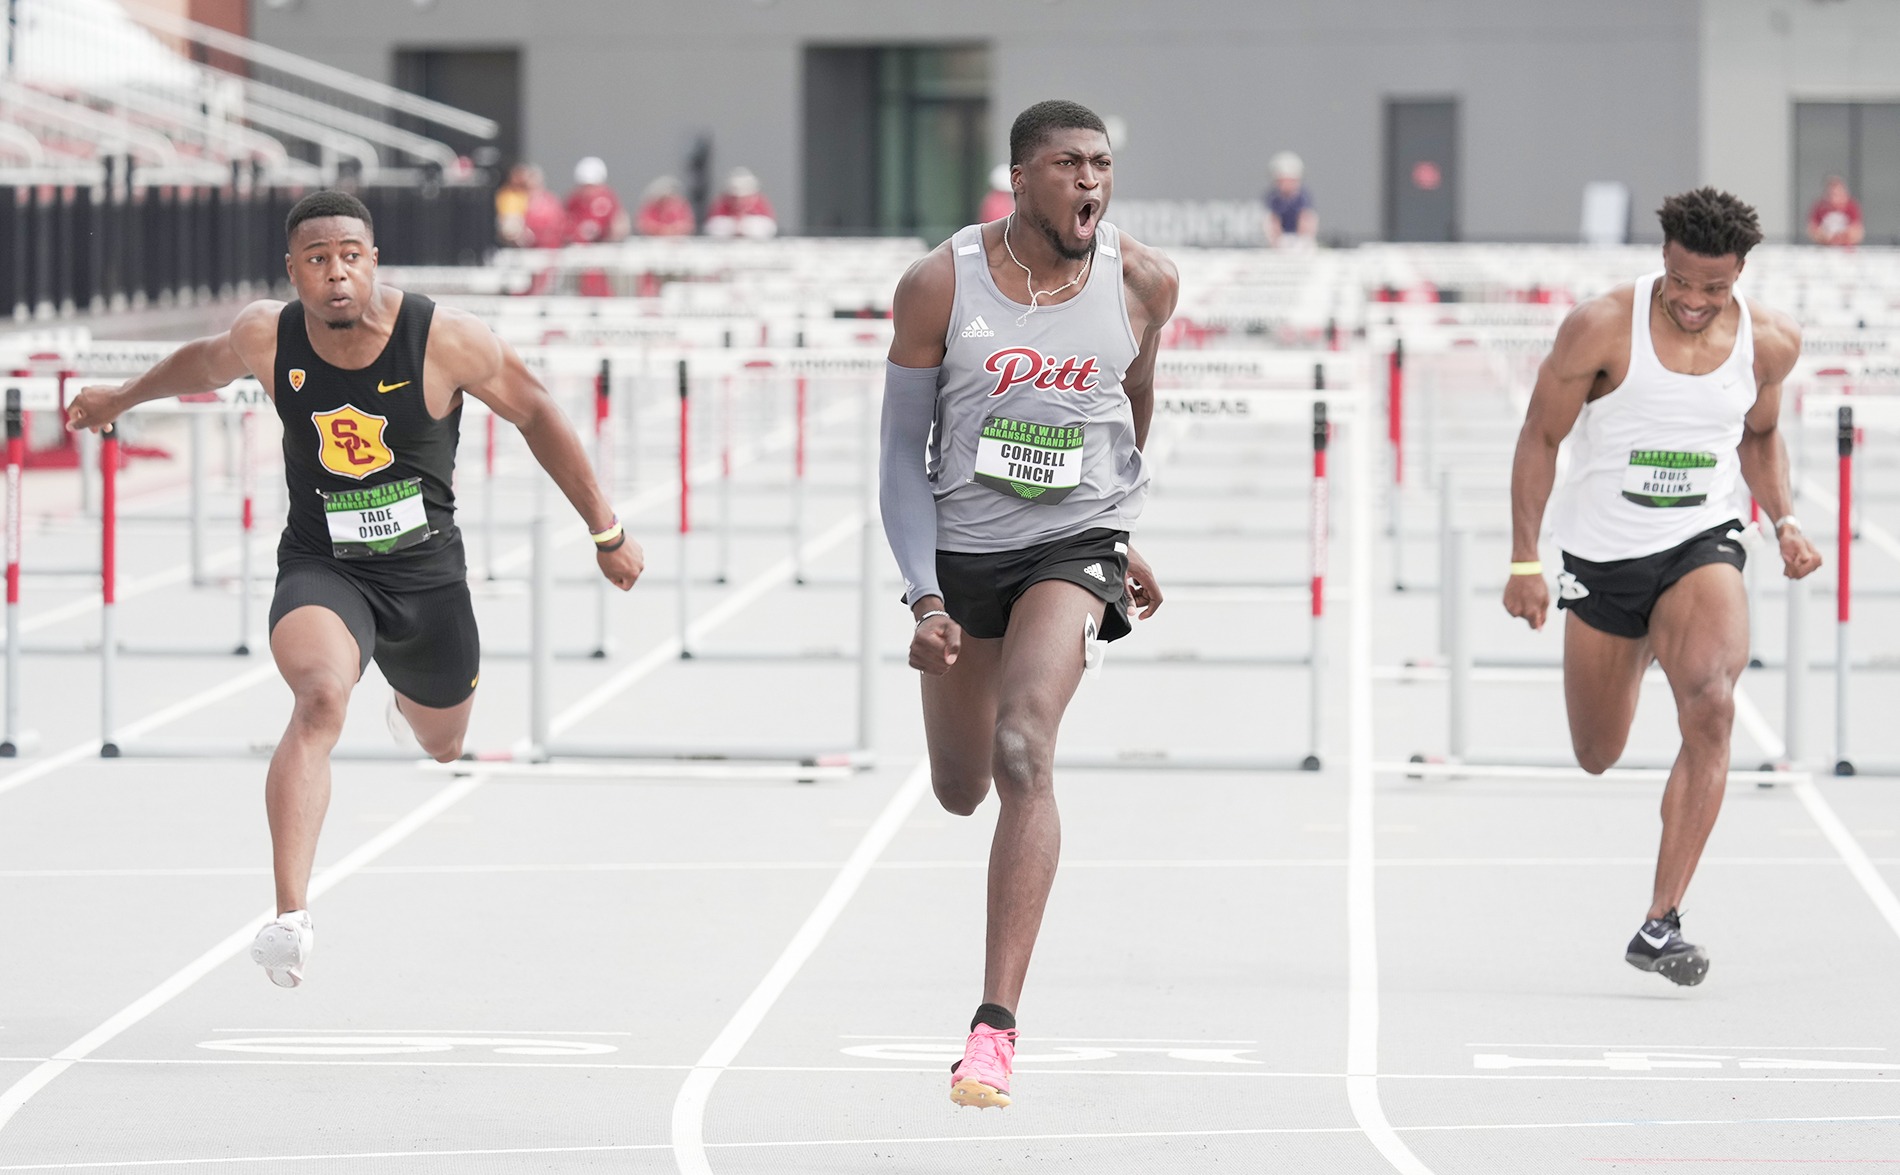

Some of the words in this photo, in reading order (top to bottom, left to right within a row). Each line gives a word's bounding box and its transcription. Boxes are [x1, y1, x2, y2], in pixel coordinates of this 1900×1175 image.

[961, 328, 995, 338] adidas
[984, 346, 1101, 398] Pitt
[983, 426, 1033, 443] ARKANSAS
[1034, 435, 1065, 448] GRAND
[1066, 436, 1083, 448] PRIX
[993, 418, 1080, 438] TRACKWIRED
[331, 418, 376, 465] SC
[1001, 444, 1065, 467] CORDELL
[1008, 462, 1055, 483] TINCH
[1653, 470, 1688, 480] LOUIS
[1643, 482, 1692, 493] ROLLINS
[360, 508, 393, 523] TADE
[359, 522, 402, 539] OJORA
